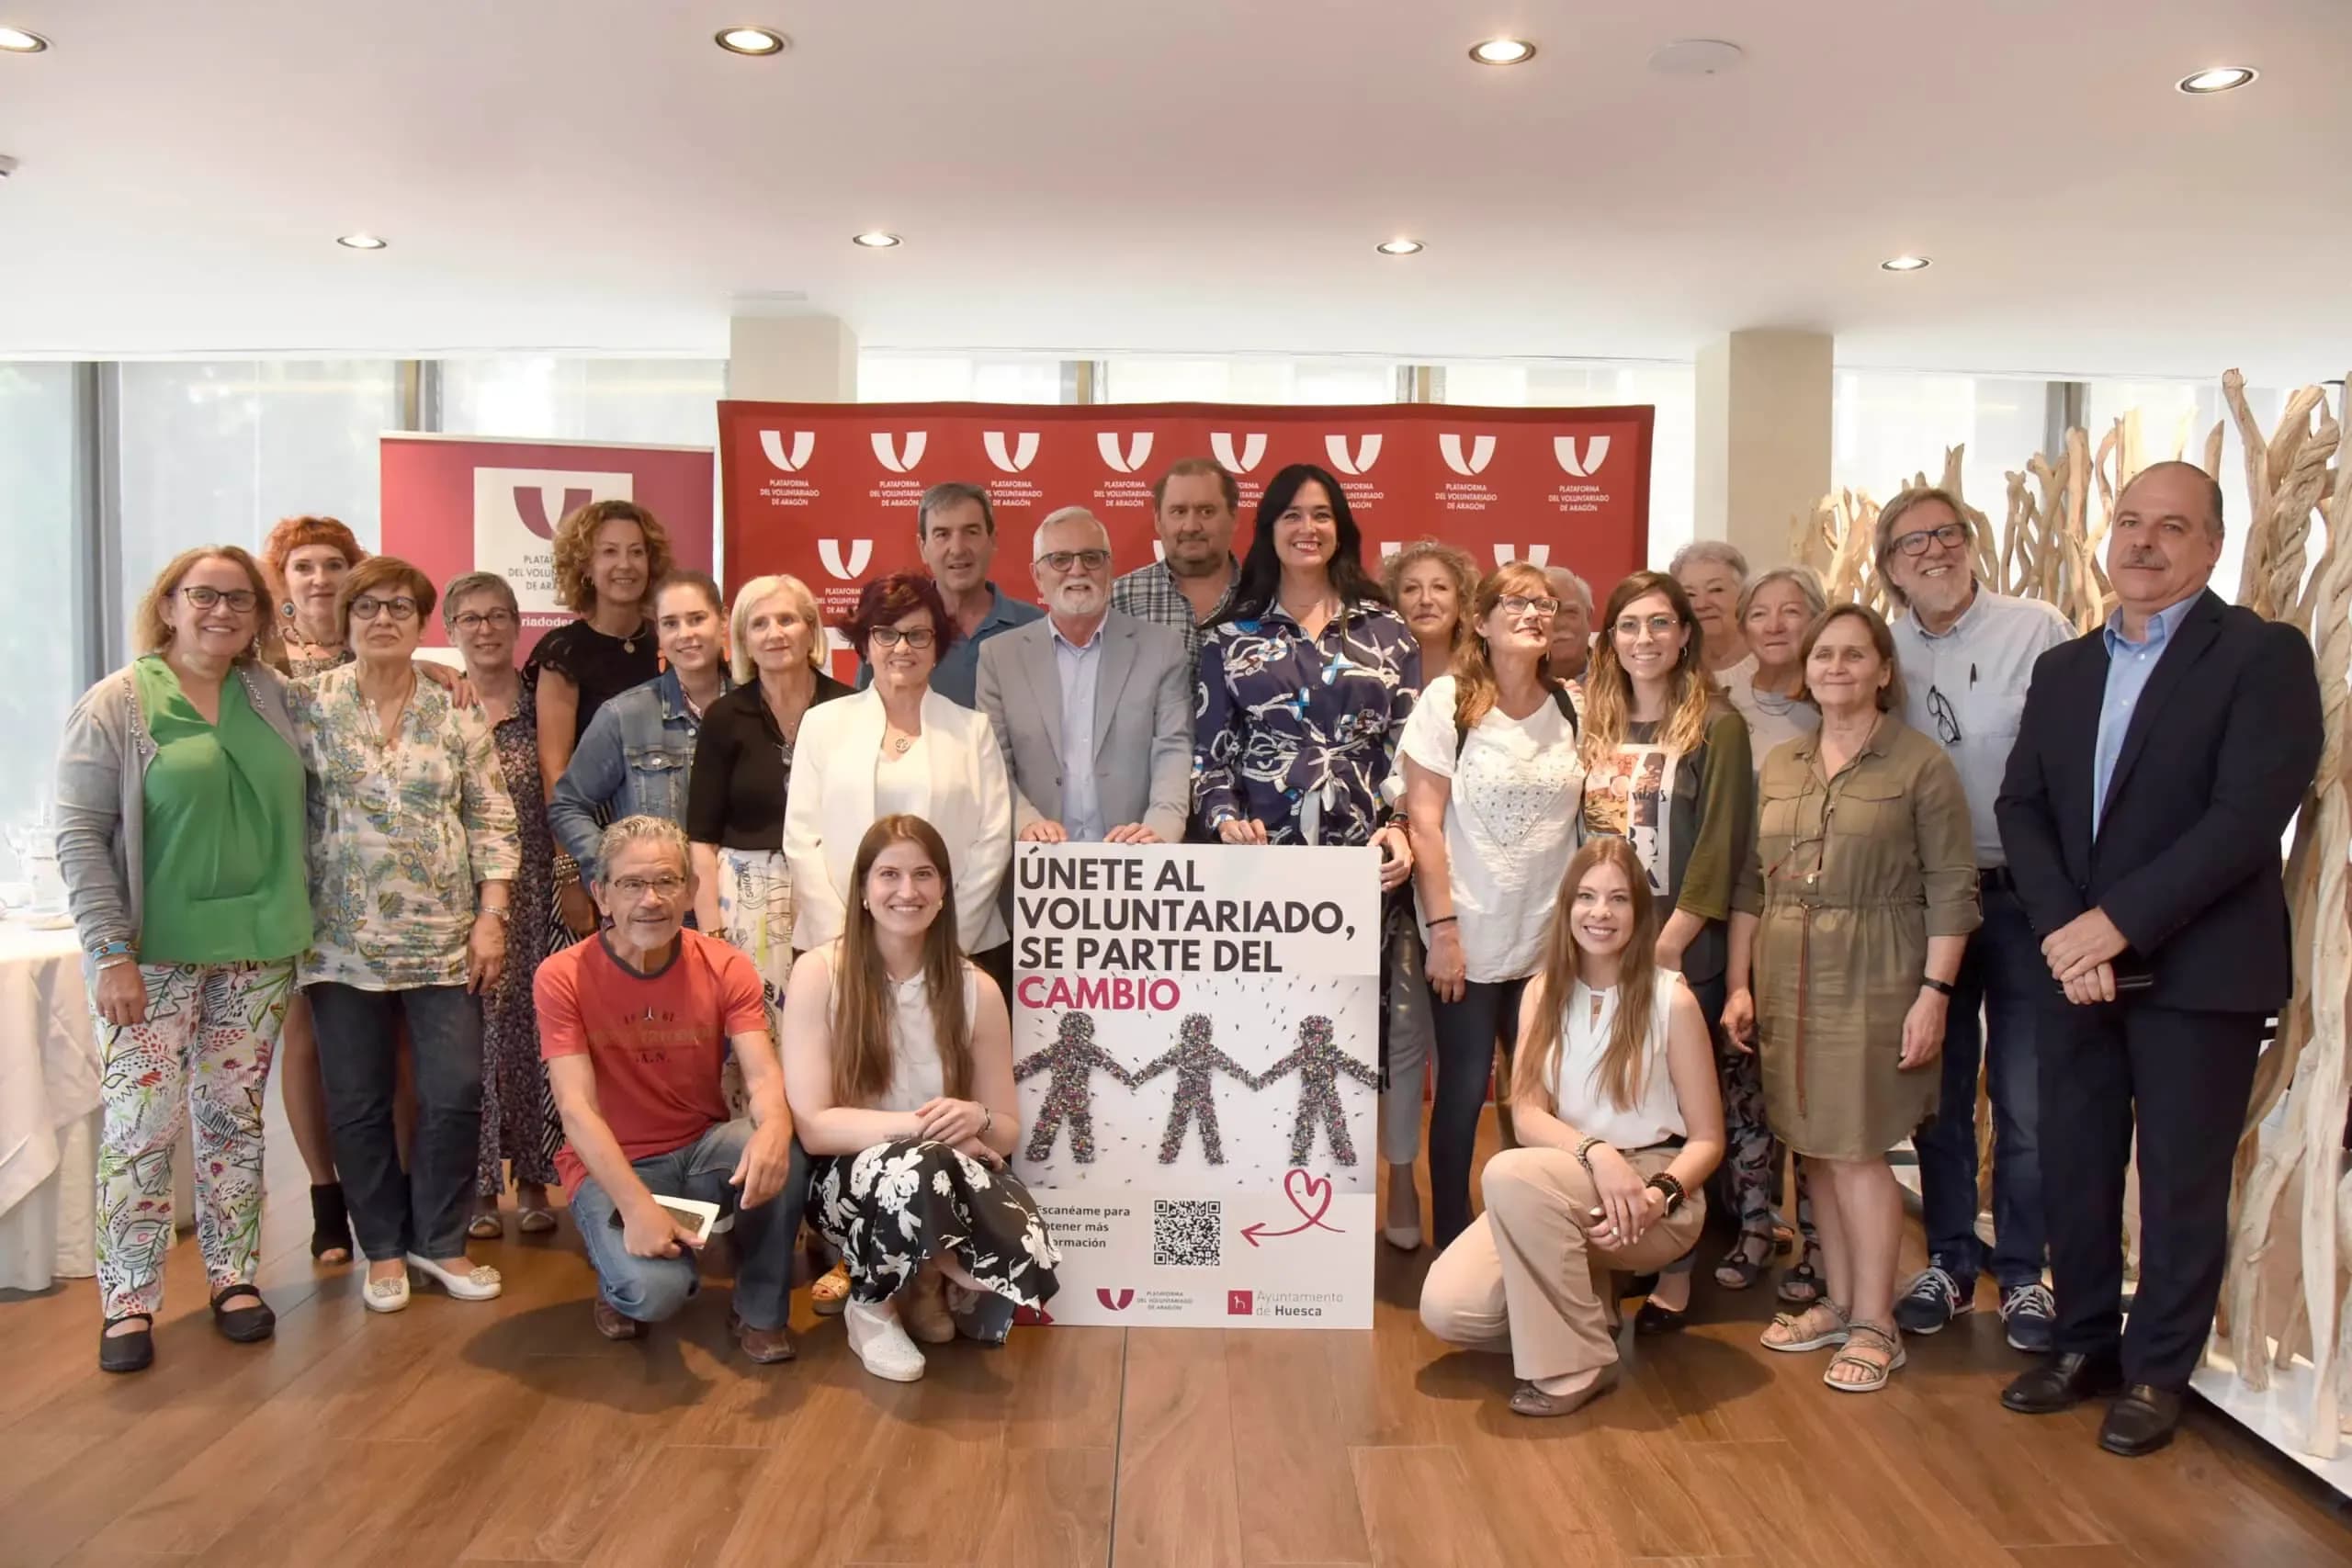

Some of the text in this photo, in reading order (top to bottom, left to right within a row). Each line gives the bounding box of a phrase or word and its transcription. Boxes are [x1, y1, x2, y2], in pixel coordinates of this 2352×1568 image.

[1445, 483, 1487, 491] PLATAFORMA
[1559, 485, 1600, 493] PLATAFORMA
[772, 489, 820, 497] VOLUNTARIADO
[1448, 493, 1498, 502] VOLUNTARIADO
[781, 497, 808, 505] ARAGÓN
[1002, 498, 1030, 507] ARAGÓN
[1115, 498, 1144, 507] ARAGÓN
[1561, 494, 1610, 502] VOLUNTARIADO
[1456, 502, 1485, 511] ARAGÓN
[1569, 503, 1598, 512] ARAGÓN
[508, 568, 524, 577] DEL
[526, 581, 537, 590] DE
[1020, 845, 1205, 892] ÚNETE AL
[1018, 897, 1355, 941] VOLUNTARIADO,
[1018, 937, 1283, 973] SE PARTE DEL
[1017, 976, 1181, 1010] CAMBIO
[1104, 1208, 1131, 1218] para
[1085, 1222, 1109, 1232] más
[1256, 1291, 1343, 1304] Ayuntamiento
[1256, 1304, 1322, 1316] de Huesca
